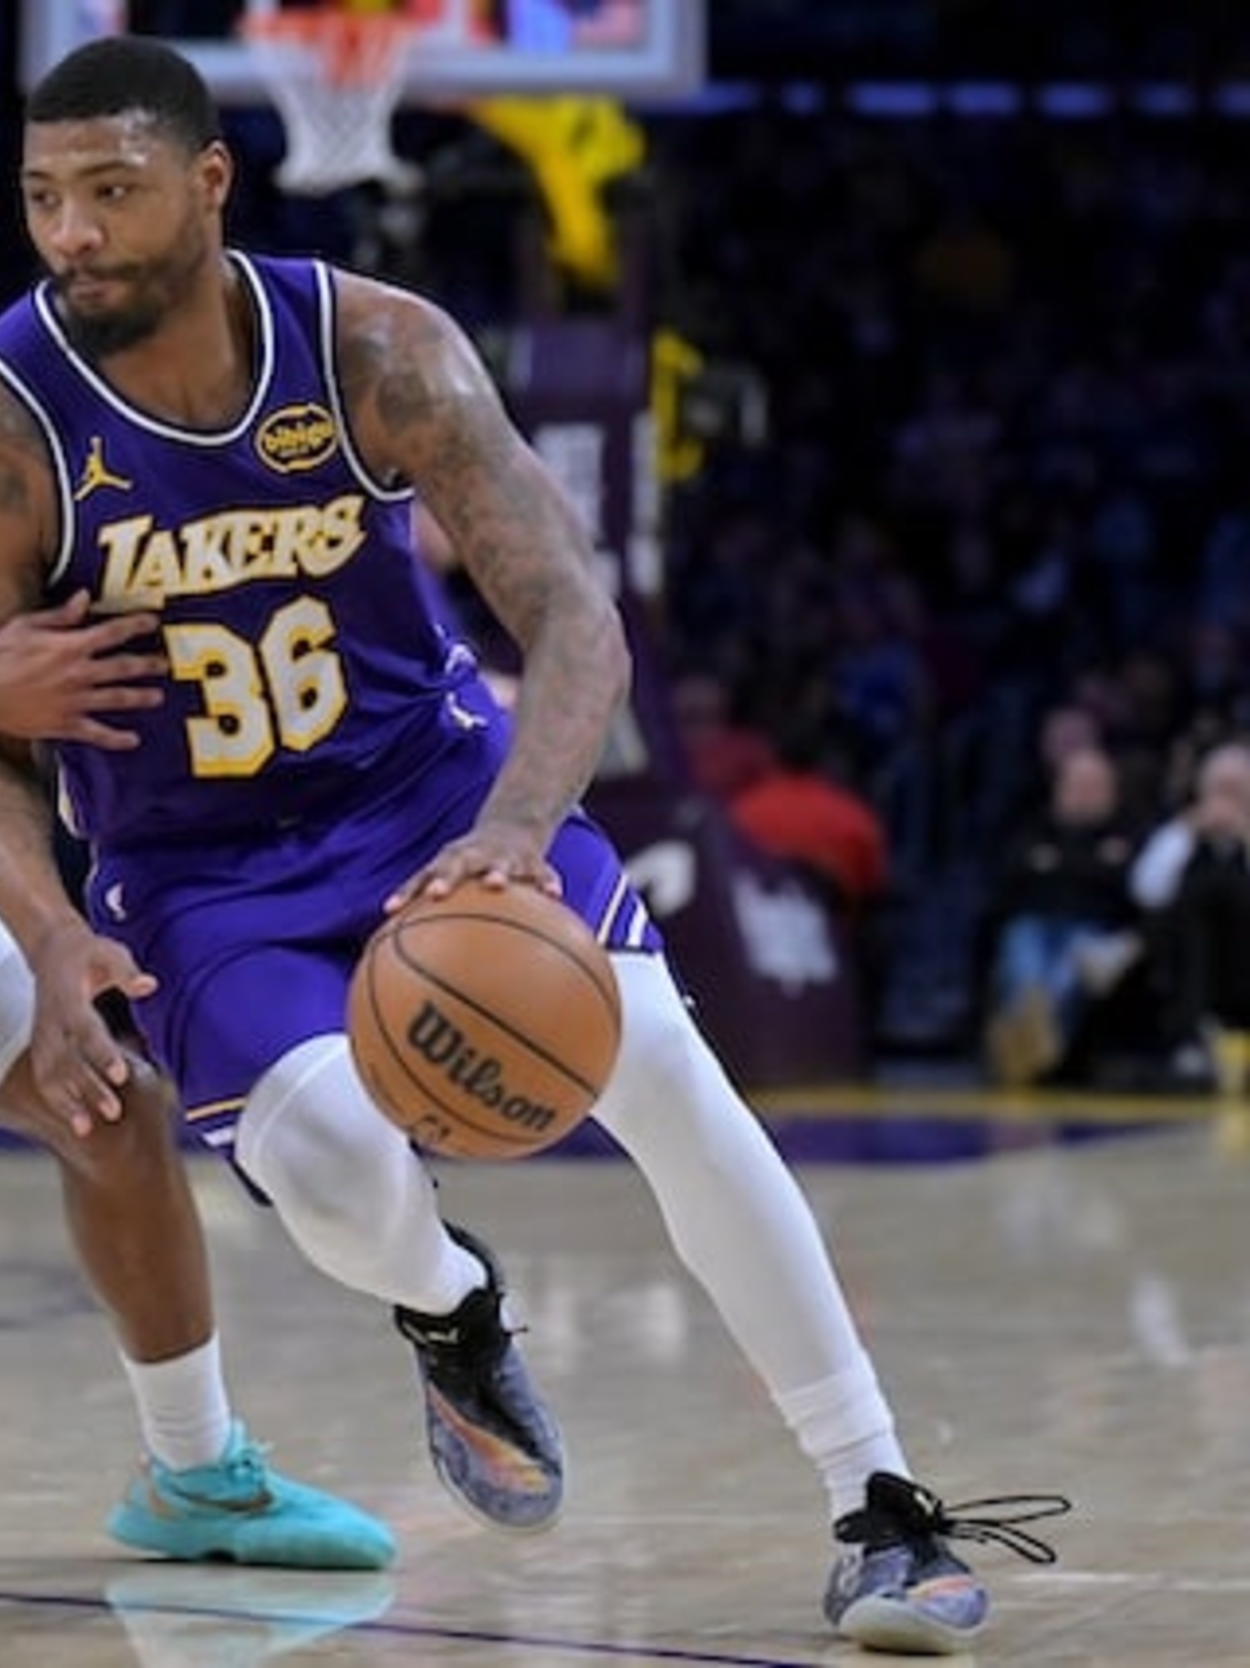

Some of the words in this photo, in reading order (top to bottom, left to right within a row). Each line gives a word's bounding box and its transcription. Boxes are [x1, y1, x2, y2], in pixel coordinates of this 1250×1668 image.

[90, 494, 367, 613] LAKERS
[162, 596, 348, 779] 36
[408, 1001, 556, 1131] Wilson
